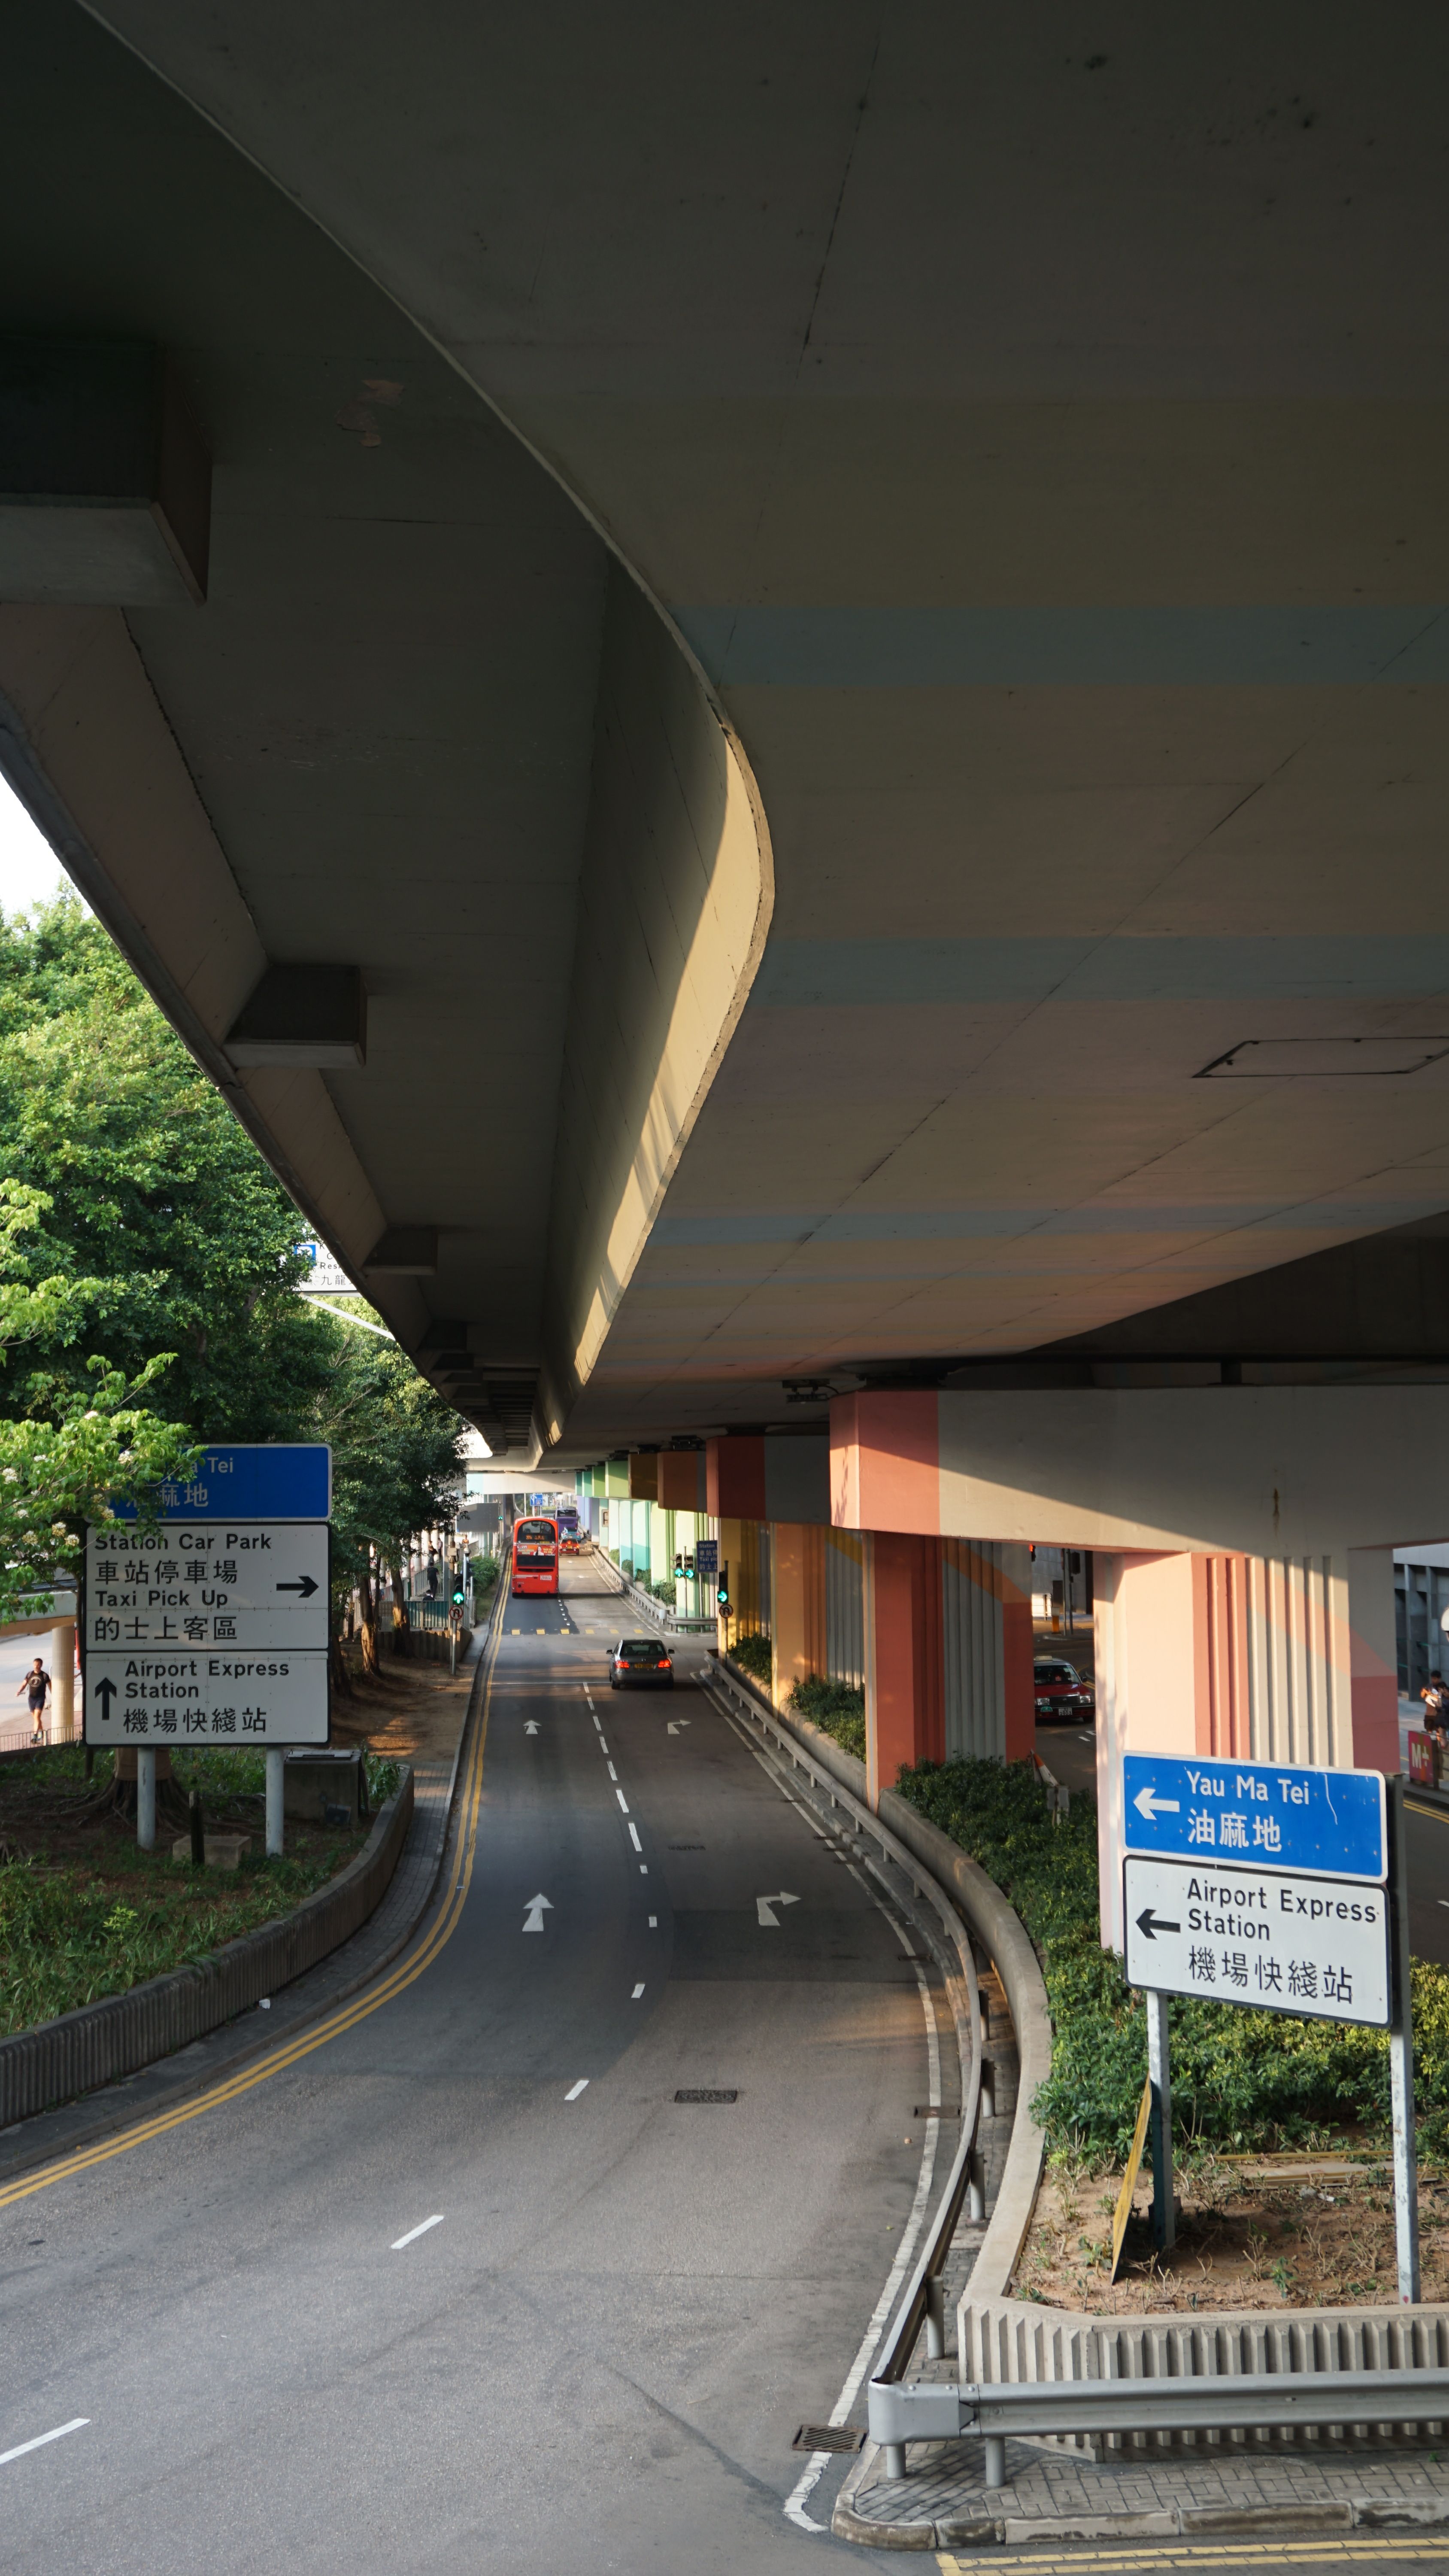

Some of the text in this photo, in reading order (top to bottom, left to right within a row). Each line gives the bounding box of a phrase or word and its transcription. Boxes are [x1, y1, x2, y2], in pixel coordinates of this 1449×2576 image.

[321, 1275, 352, 1285] 九龍
[207, 1458, 233, 1473] Tei
[179, 1534, 214, 1550] Car
[226, 1534, 271, 1549] Park
[95, 1560, 237, 1585] 車站停車場
[95, 1590, 228, 1608] Taxi Pick Up
[95, 1616, 237, 1641] 的士上客區
[125, 1660, 289, 1679] Airport Express
[125, 1682, 199, 1698] Station
[124, 1707, 267, 1733] 機場快綫站
[1411, 1742, 1429, 1769] M+
[1186, 1771, 1309, 1805] Yau Ma Tei
[1188, 1808, 1282, 1852] 油麻地
[1187, 1878, 1376, 1923] Airport Express
[1188, 1908, 1270, 1941] Station
[1189, 1945, 1353, 2005] 機場快綫站
